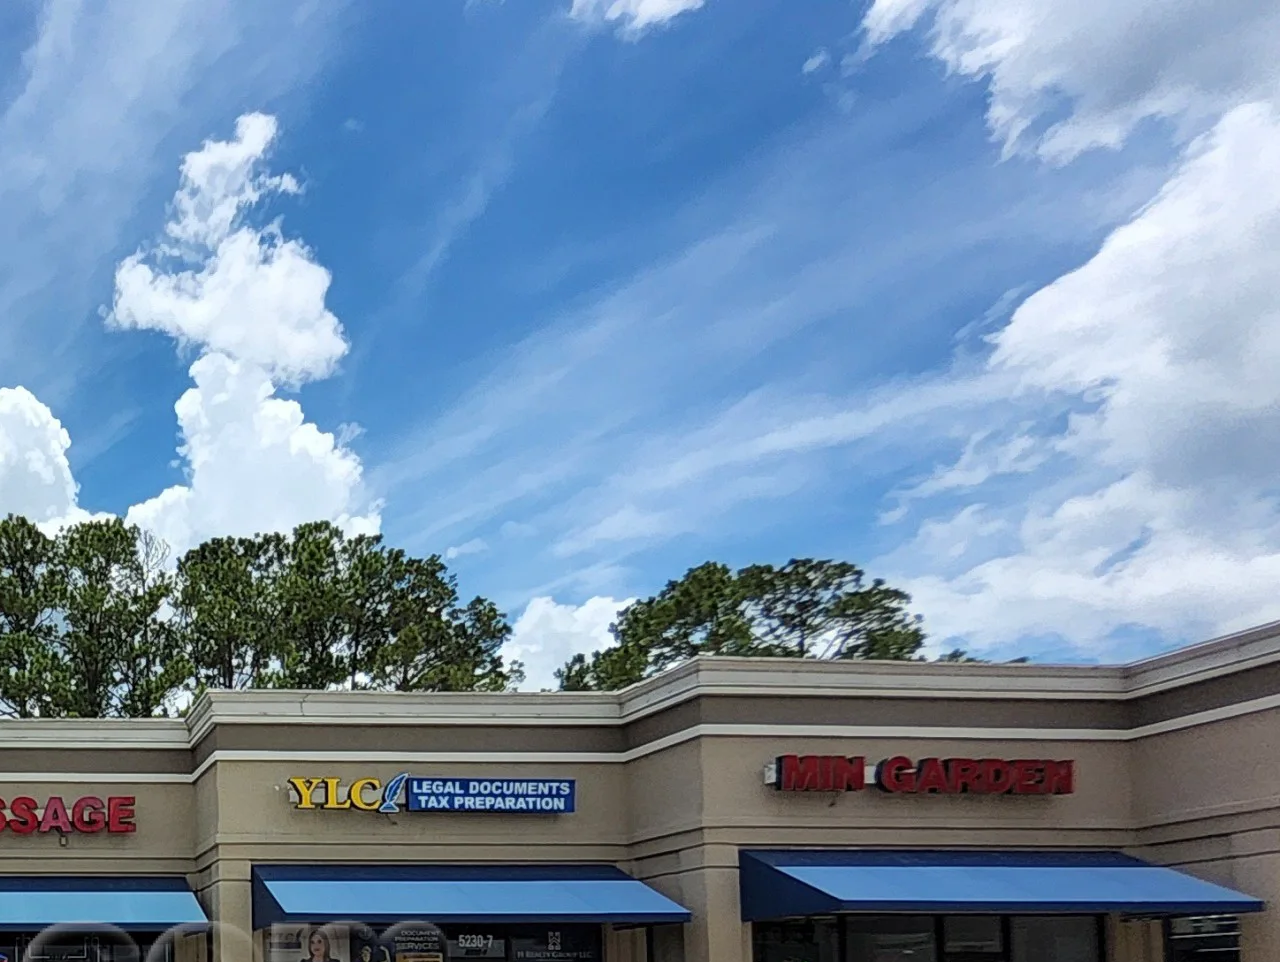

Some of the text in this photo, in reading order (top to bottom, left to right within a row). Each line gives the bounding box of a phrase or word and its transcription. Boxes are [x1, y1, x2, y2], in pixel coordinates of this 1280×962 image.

[775, 754, 1075, 794] MIN GARDEN
[290, 777, 382, 811] YLC
[412, 780, 570, 795] LEGAL DOCUMENTS
[418, 795, 565, 810] TAX PREPARATION
[458, 934, 493, 948] 5230-7
